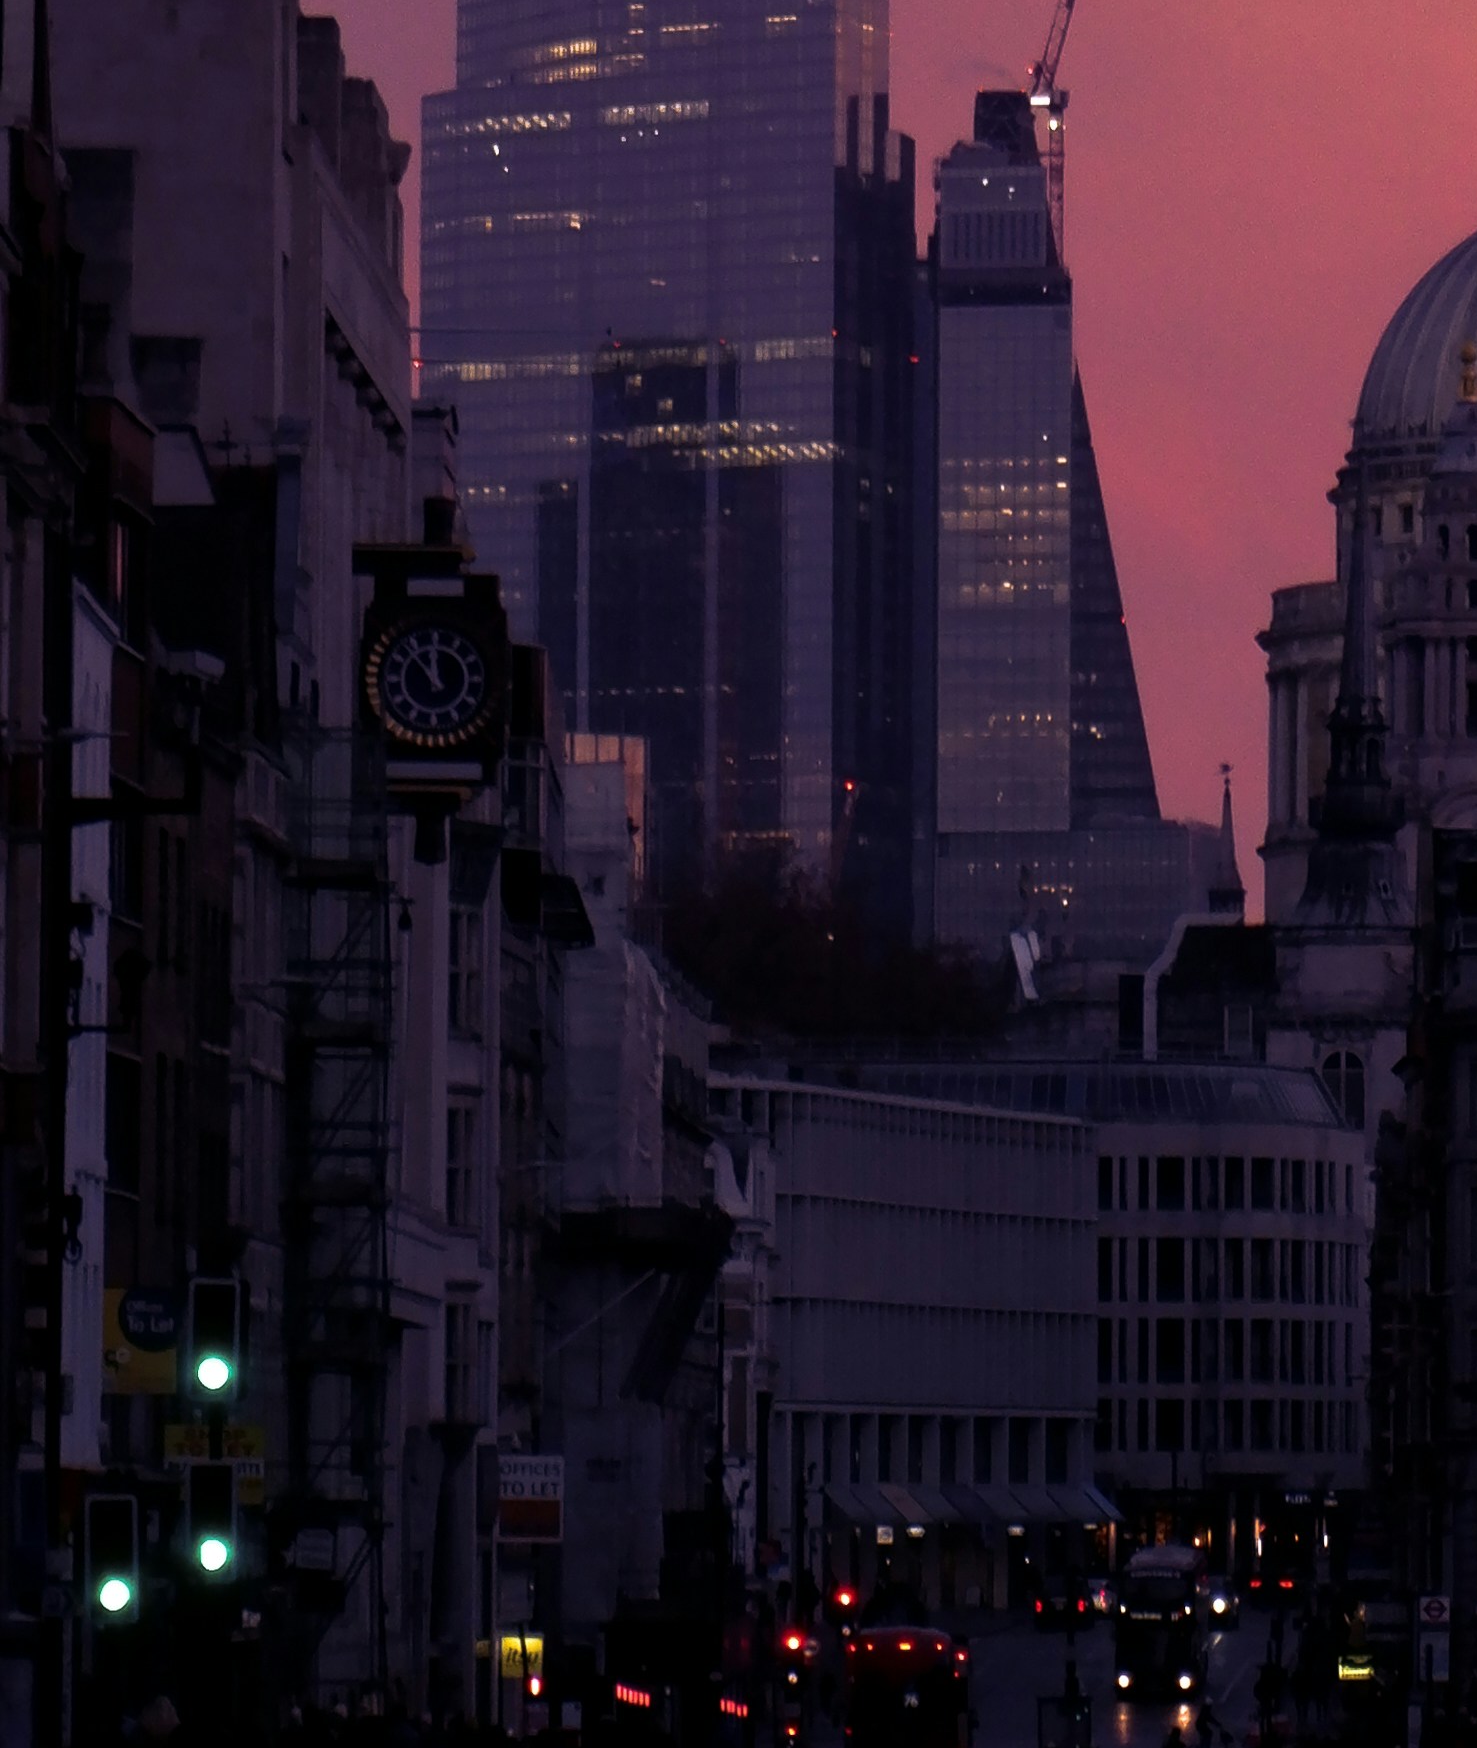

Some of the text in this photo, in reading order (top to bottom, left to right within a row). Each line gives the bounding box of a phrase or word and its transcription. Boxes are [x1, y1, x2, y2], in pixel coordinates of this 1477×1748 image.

[500, 1462, 561, 1476] OFFICES
[500, 1480, 559, 1497] TO LET
